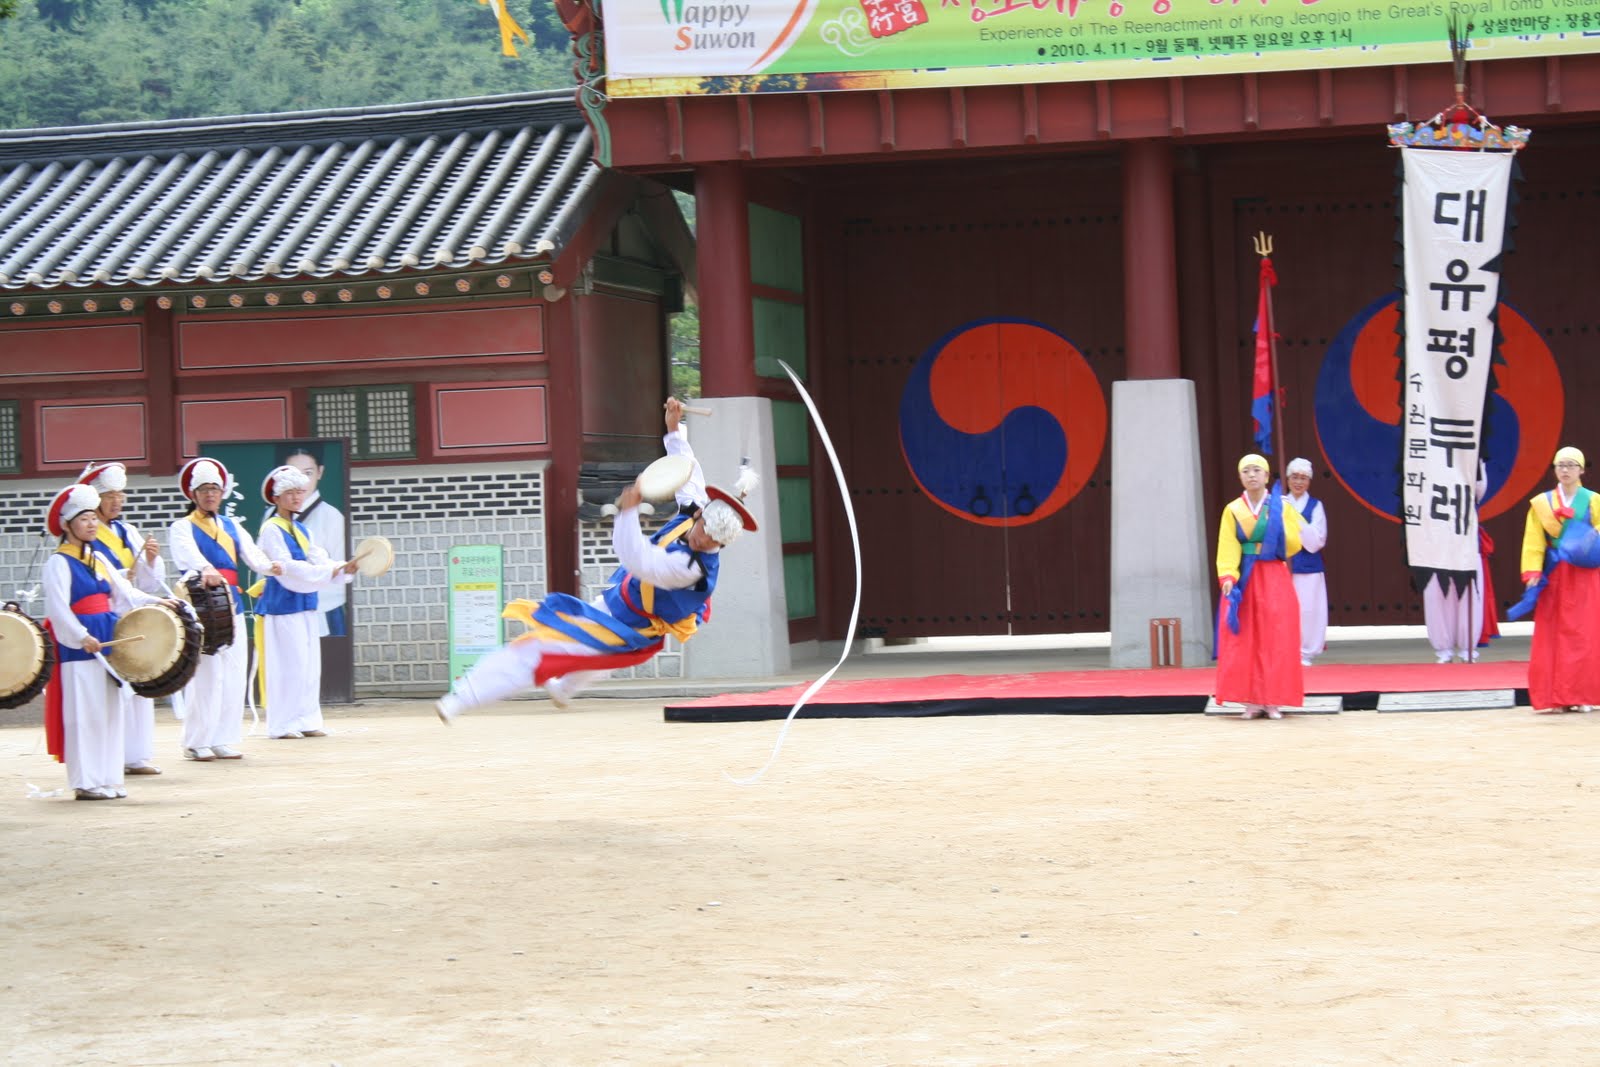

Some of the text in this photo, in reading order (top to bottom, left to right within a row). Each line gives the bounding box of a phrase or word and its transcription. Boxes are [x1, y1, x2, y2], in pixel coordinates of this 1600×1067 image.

[980, 25, 1063, 41] Experience
[1070, 23, 1083, 37] of
[1090, 22, 1119, 35] The
[1124, 17, 1223, 34] Reenactment
[1229, 16, 1243, 29] of
[1250, 13, 1284, 28] King
[1290, 9, 1351, 25] Jeongjo
[1357, 7, 1382, 21] the
[1388, 3, 1443, 19] Great's
[1450, 0, 1493, 16] Royal
[1481, 15, 1551, 34] 상설한마당
[674, 26, 756, 51] Suwon
[1051, 43, 1089, 57] 2010.
[1111, 41, 1126, 55] 11
[1146, 38, 1167, 54] 9월
[1254, 31, 1293, 48] 일요일
[1299, 29, 1326, 45] 오후
[1331, 28, 1352, 42] 1시
[1427, 189, 1487, 536] 대유평 두레
[1405, 372, 1428, 526] 수원문화원
